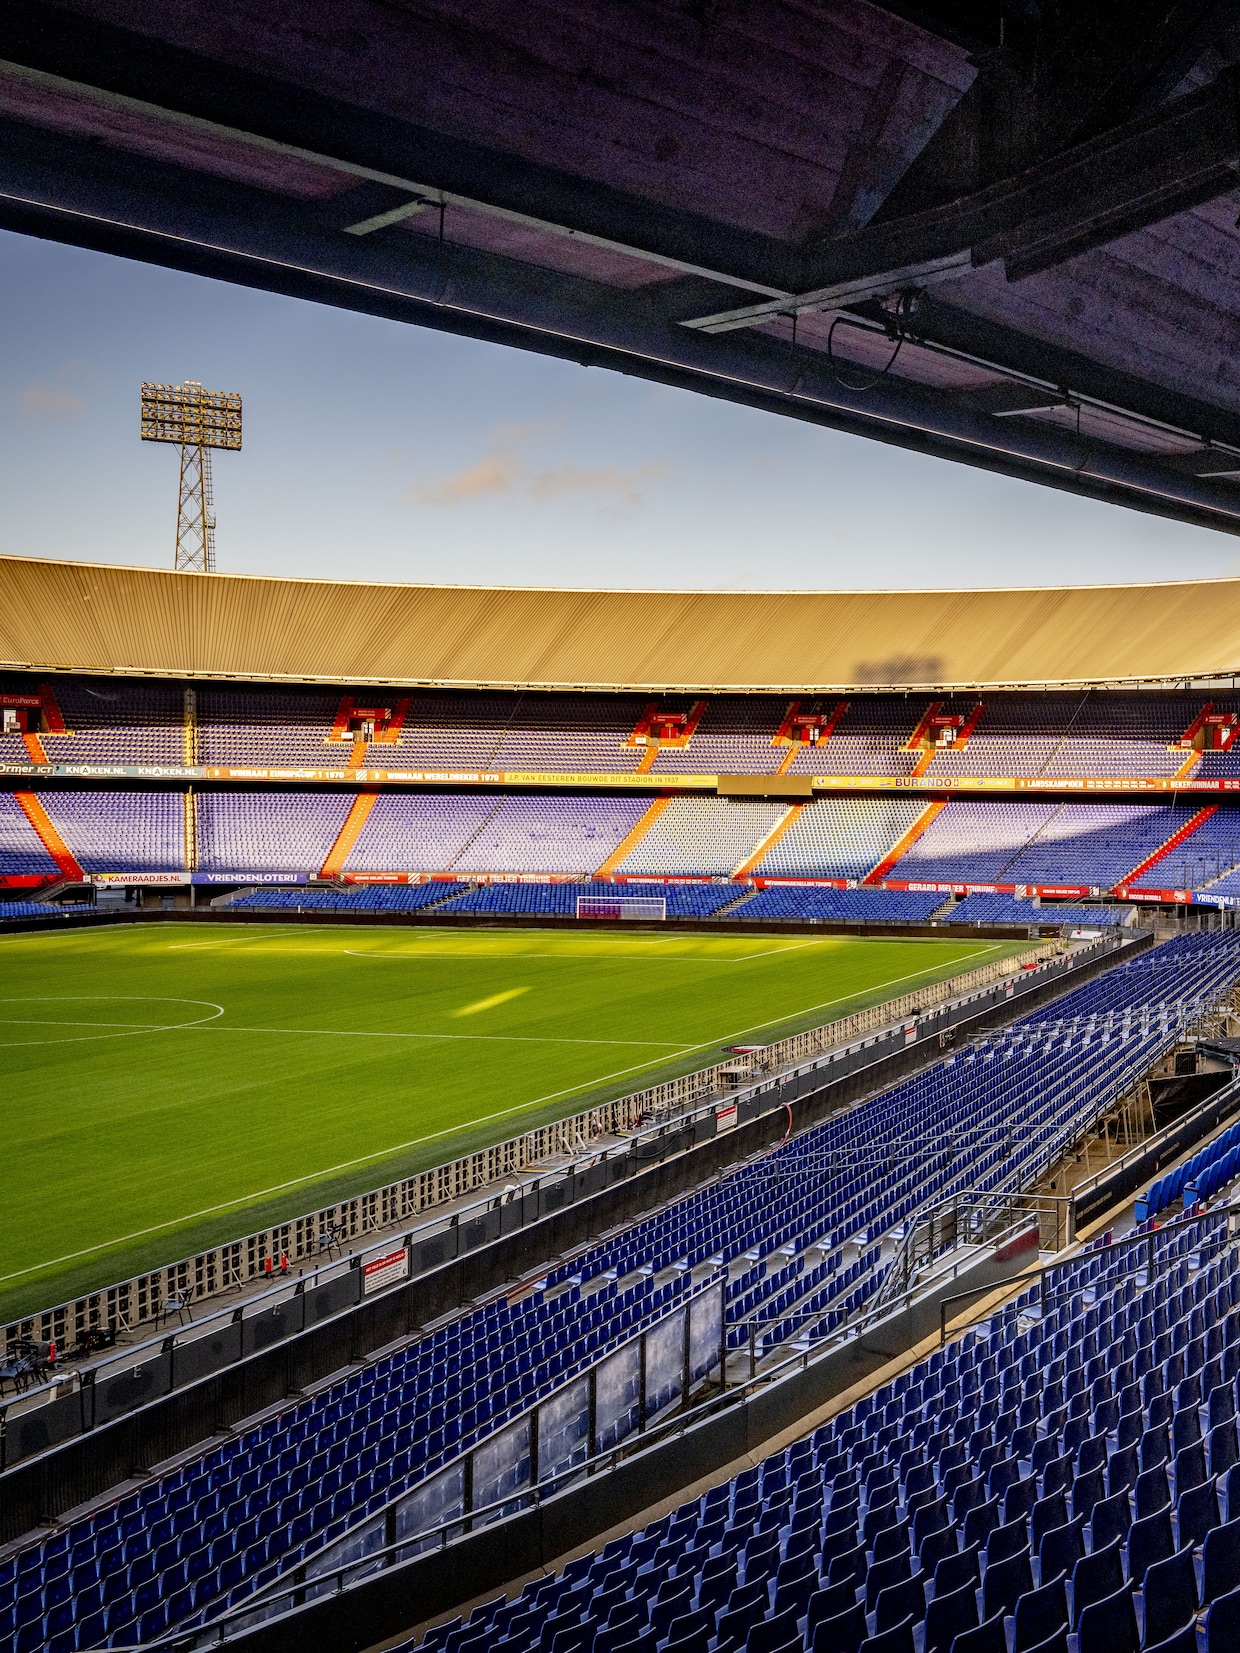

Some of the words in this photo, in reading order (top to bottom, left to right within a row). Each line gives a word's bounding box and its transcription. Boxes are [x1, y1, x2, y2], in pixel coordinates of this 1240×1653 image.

[3, 696, 39, 705] EuroParcs
[65, 765, 127, 775] KNAKEN.NL
[138, 766, 198, 776] KNAKEN.NL
[229, 769, 268, 777] WINNAAR
[387, 772, 423, 780] WINNAAR
[424, 773, 479, 781] WERELDBEKER
[480, 773, 499, 781] 1970
[895, 778, 952, 787] BURANDO
[1027, 780, 1084, 788] LANDSKAMPIOEN
[1170, 781, 1220, 789] BEKERWINNAAR
[108, 875, 181, 883] KAMERAADJES.NL
[207, 873, 298, 882] VRIENDENLOTERIJ
[908, 883, 936, 891] GERARD
